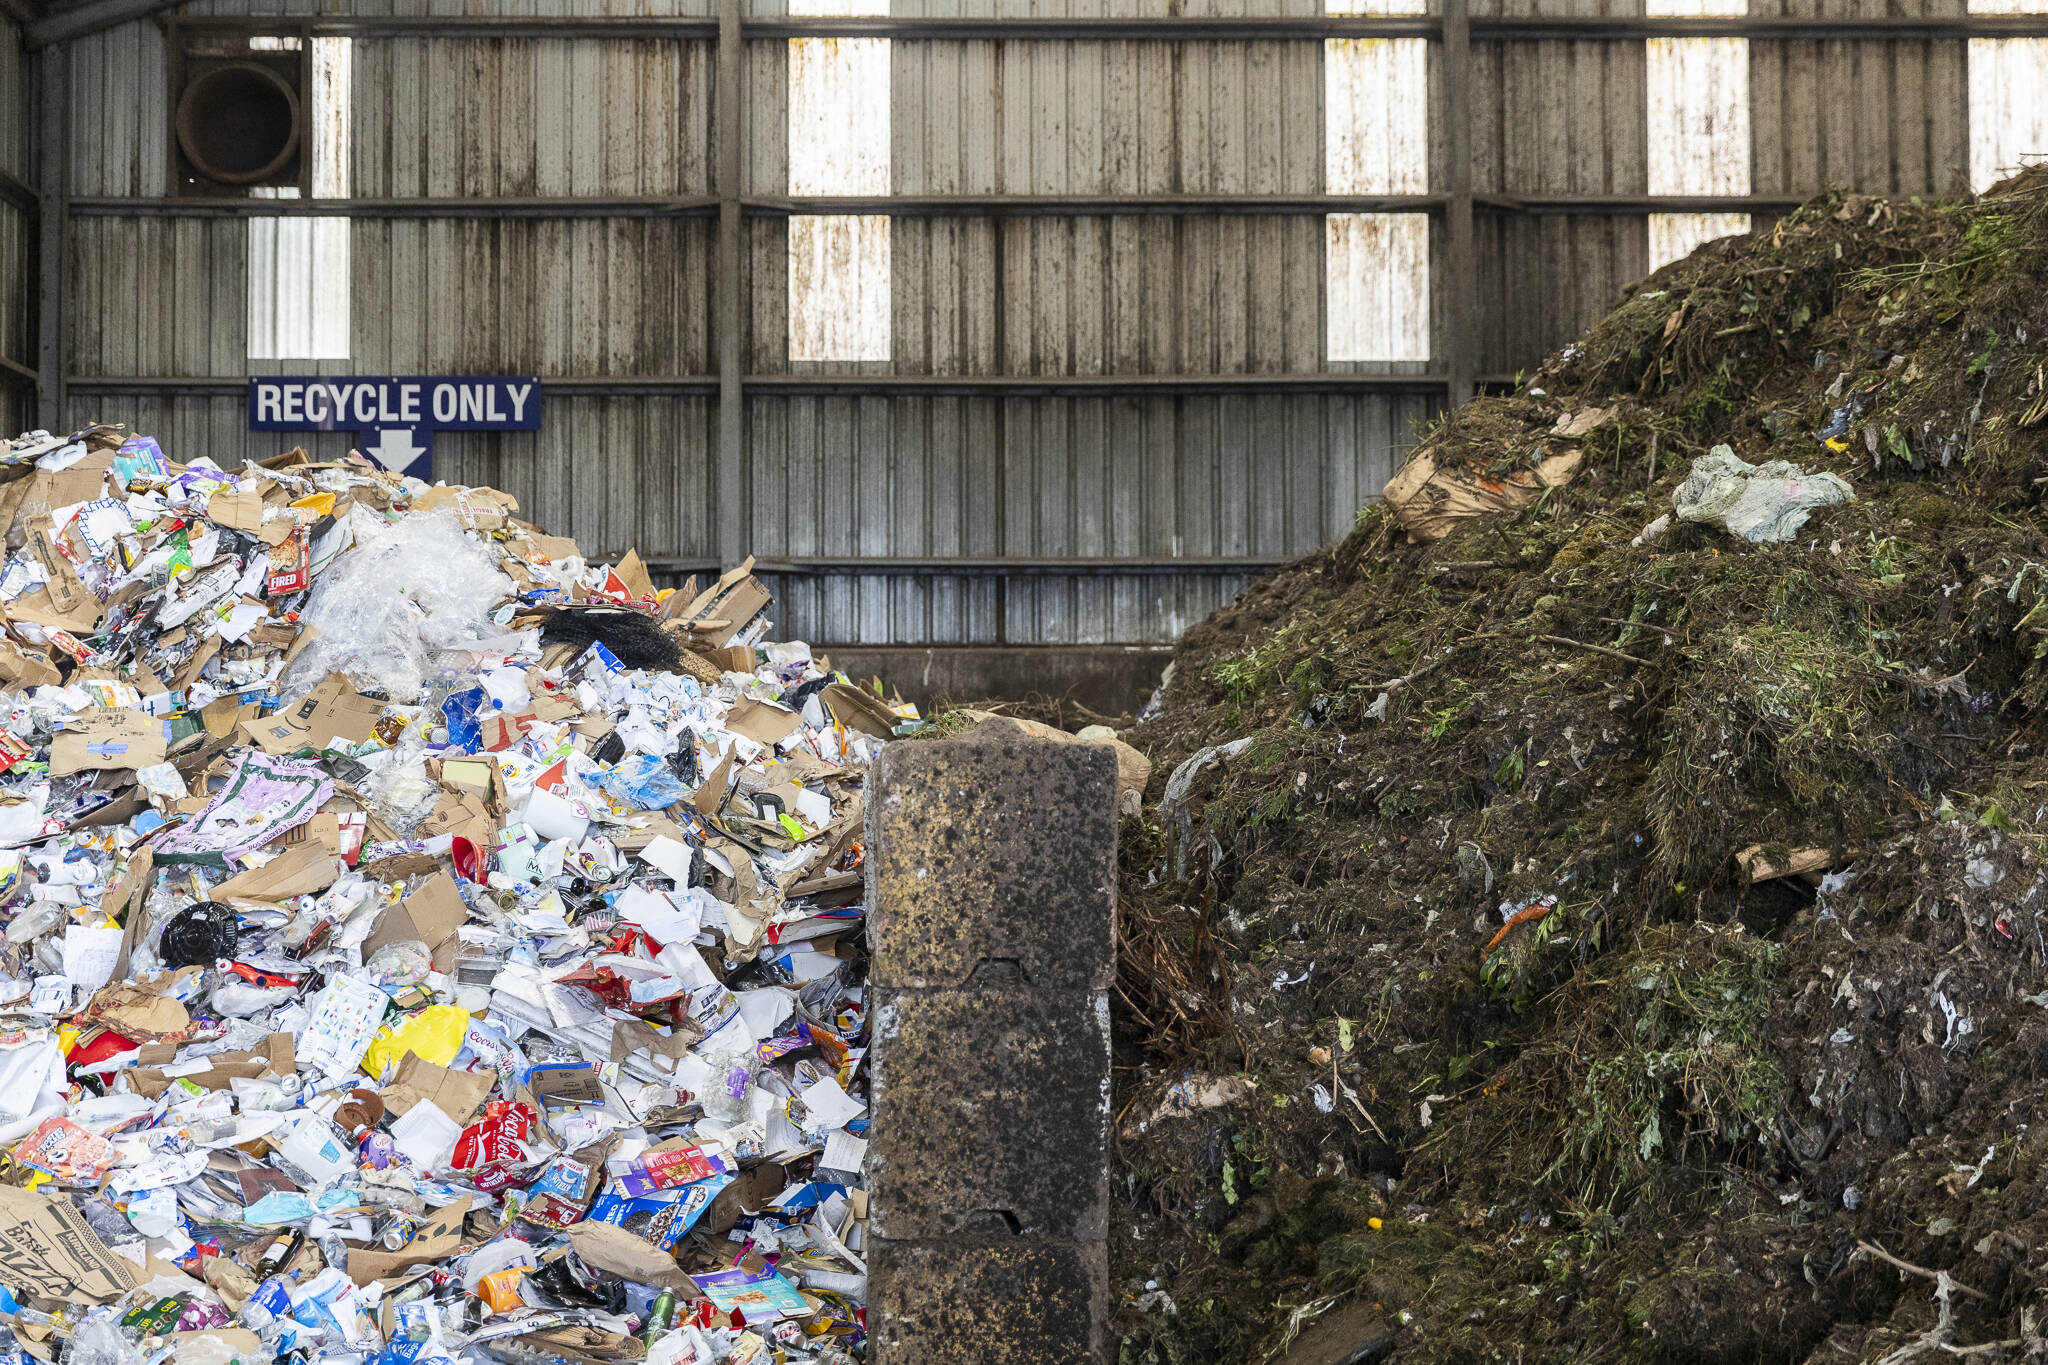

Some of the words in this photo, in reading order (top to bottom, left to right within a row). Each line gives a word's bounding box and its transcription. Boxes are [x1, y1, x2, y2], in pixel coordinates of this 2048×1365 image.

[257, 384, 421, 423] RECYCLE
[432, 384, 532, 423] ONLY
[271, 573, 297, 589] FIRED
[470, 1031, 495, 1049] Coors
[497, 1108, 526, 1161] Coca-Col
[603, 1204, 619, 1224] REO
[66, 1232, 101, 1269] KIRKLAND
